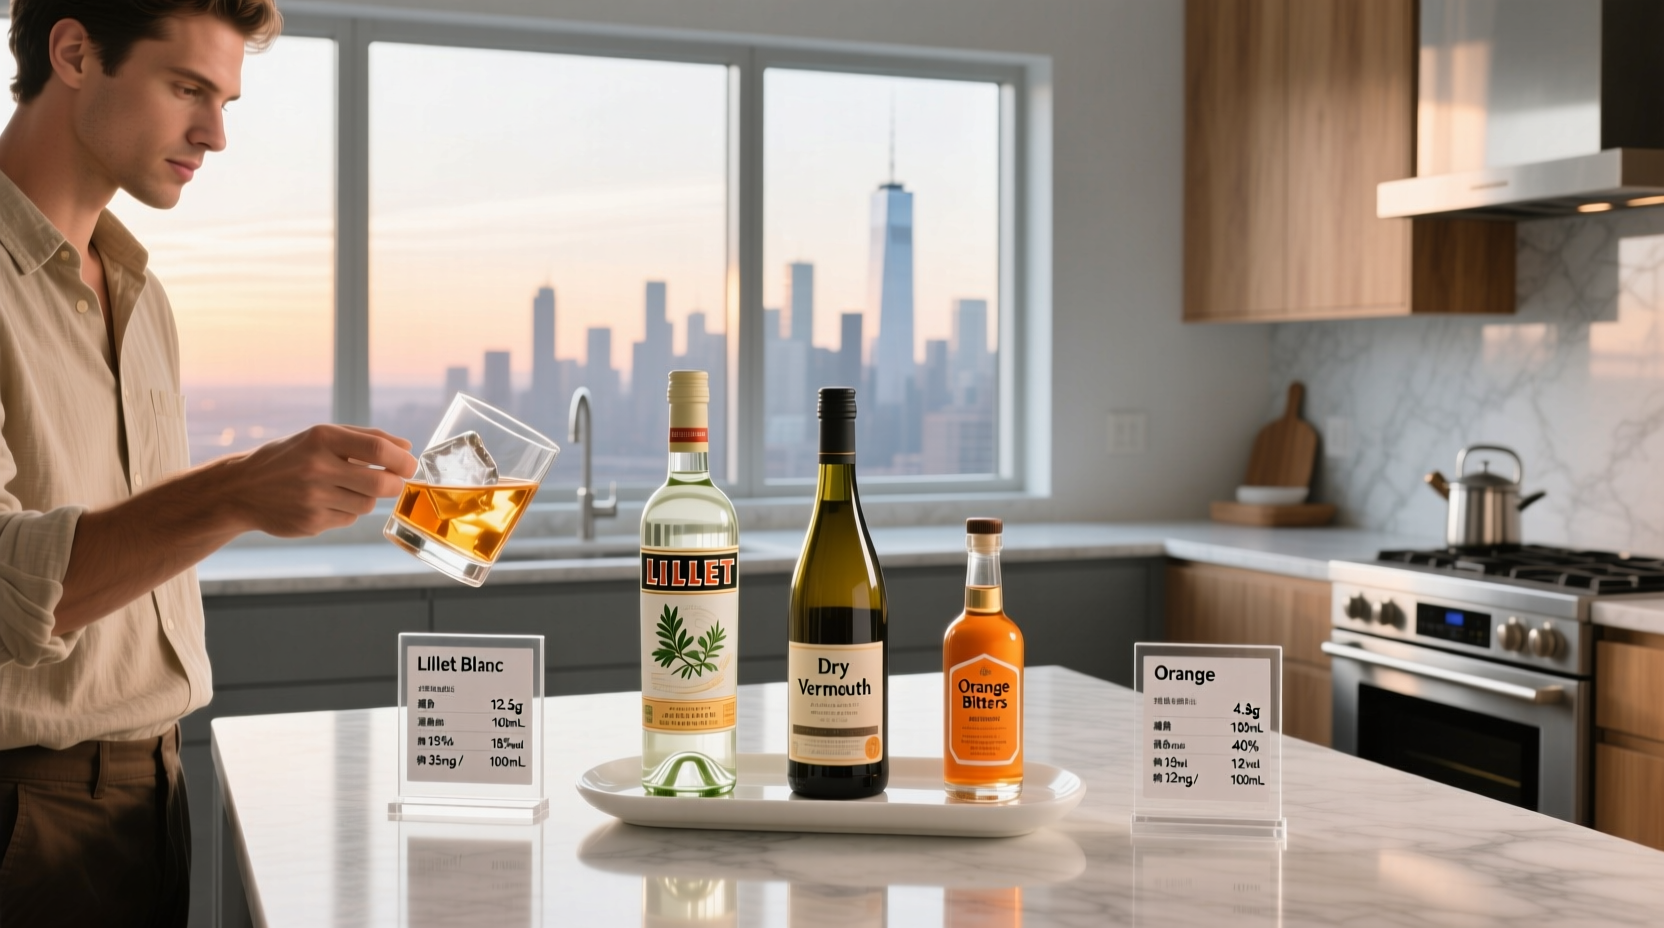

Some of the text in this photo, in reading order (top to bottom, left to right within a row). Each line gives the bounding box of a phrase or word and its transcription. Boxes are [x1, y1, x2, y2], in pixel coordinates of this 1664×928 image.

[646, 558, 735, 587] LILLET
[461, 655, 504, 673] Blanc
[818, 657, 850, 680] Dry
[1154, 664, 1216, 686] Orange
[797, 677, 871, 697] Vermouth
[958, 678, 1010, 697] Orange
[1231, 739, 1260, 753] 40%
[489, 755, 527, 768] 100mL
[1230, 773, 1266, 786] 100mL
